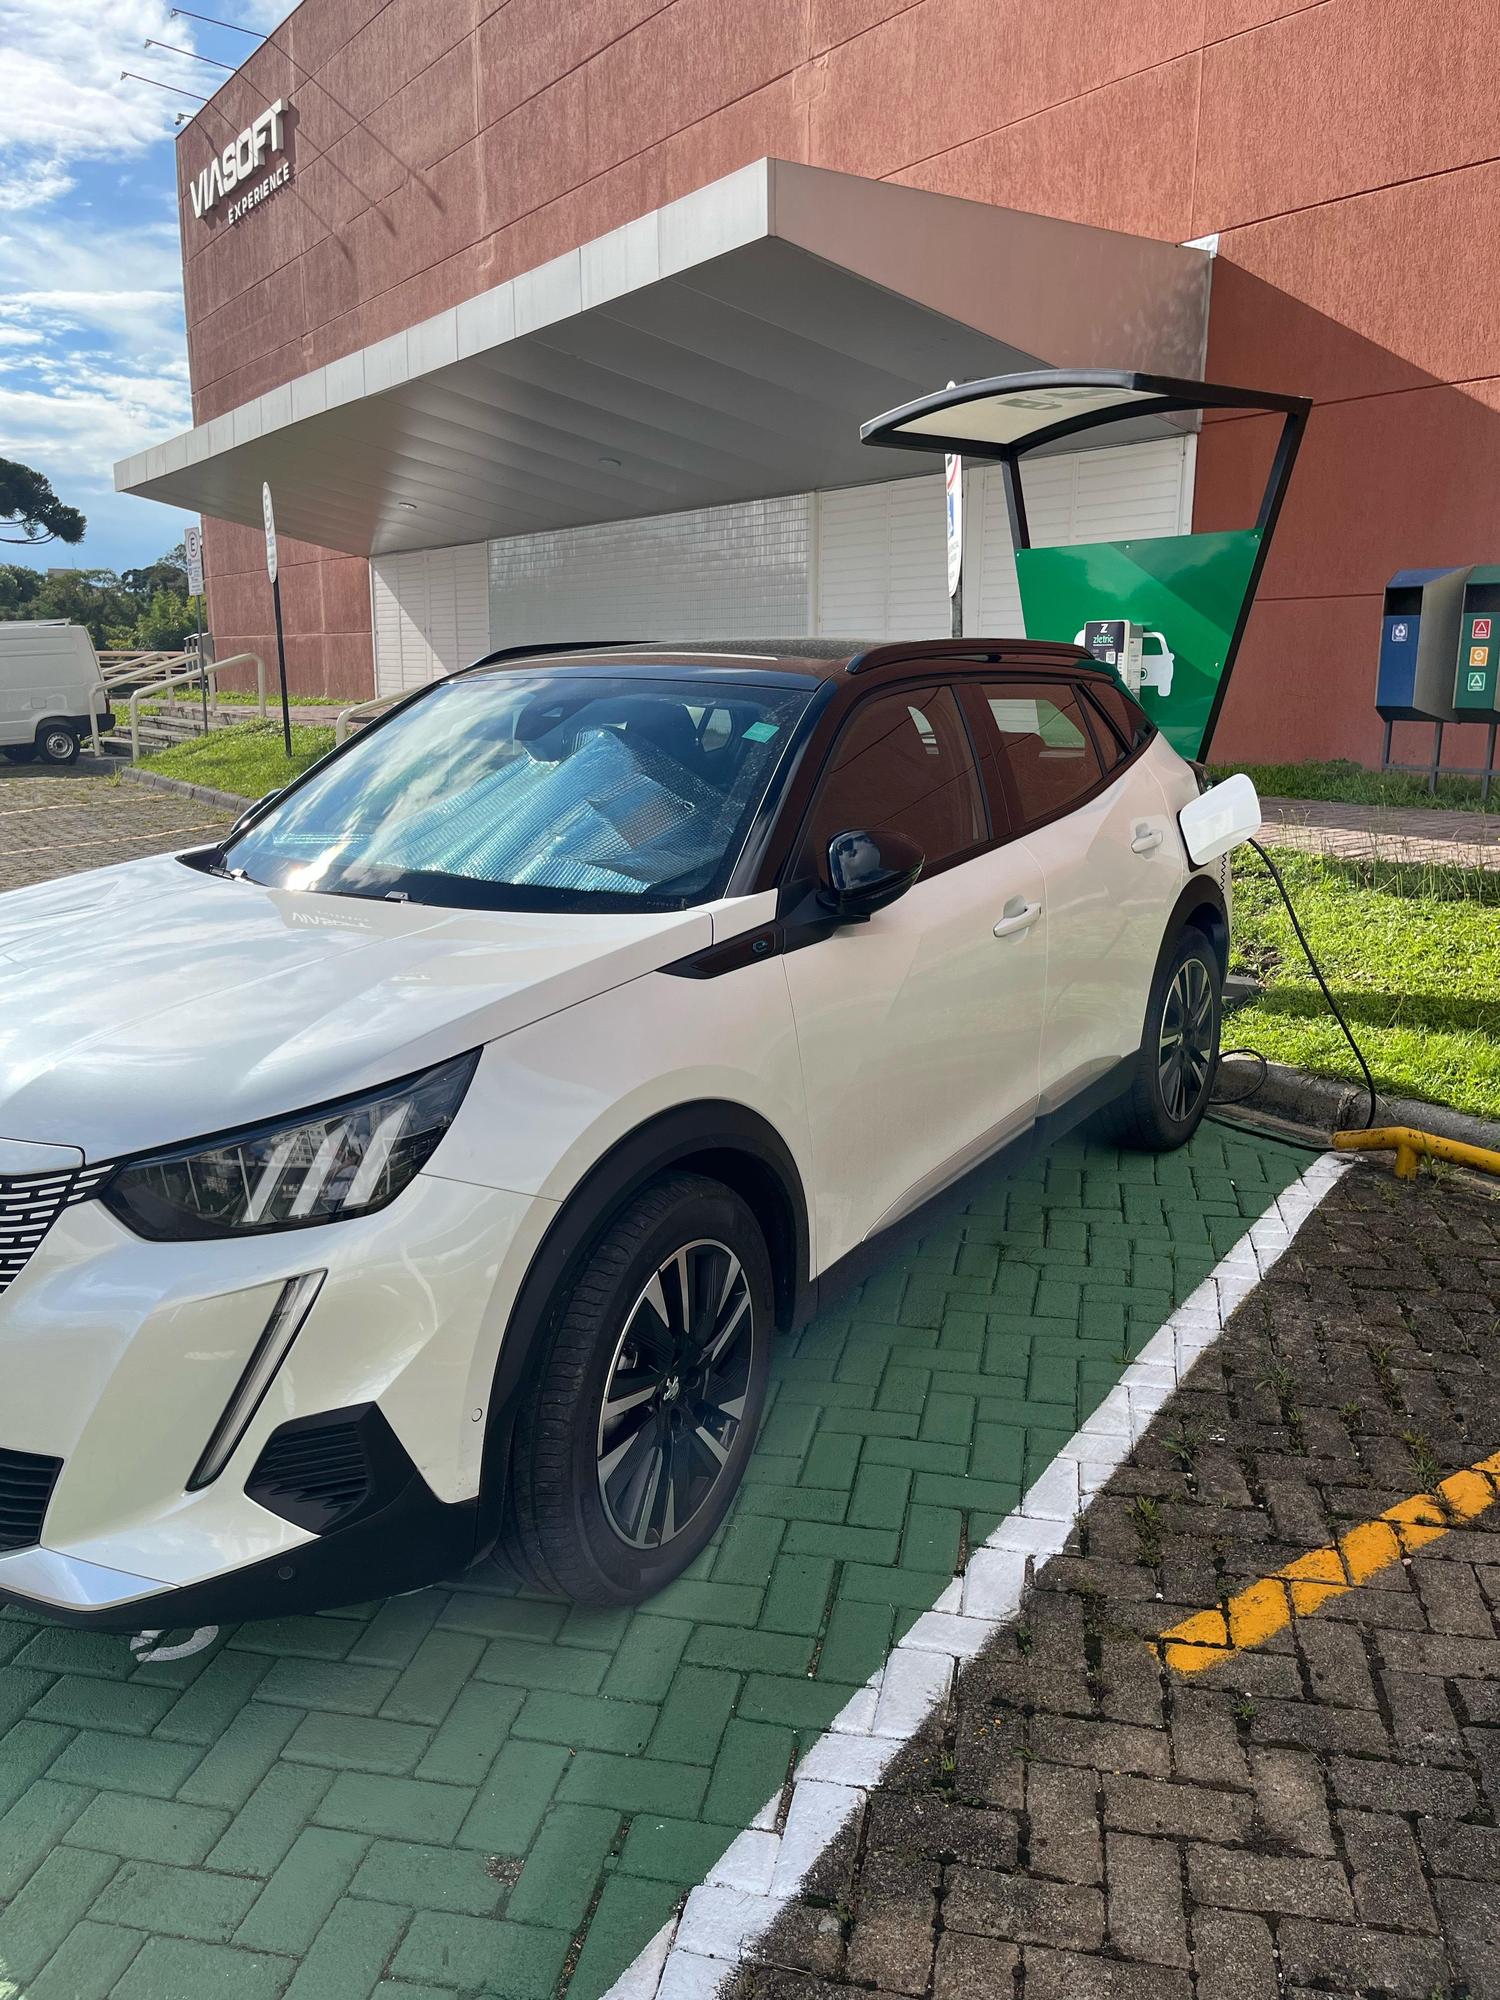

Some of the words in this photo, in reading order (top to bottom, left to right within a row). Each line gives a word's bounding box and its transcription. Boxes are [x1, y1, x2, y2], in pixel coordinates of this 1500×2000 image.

[190, 98, 285, 218] VIASOFT
[228, 162, 289, 224] EXPERIENCE
[190, 537, 196, 552] E
[1093, 634, 1114, 644] zletric
